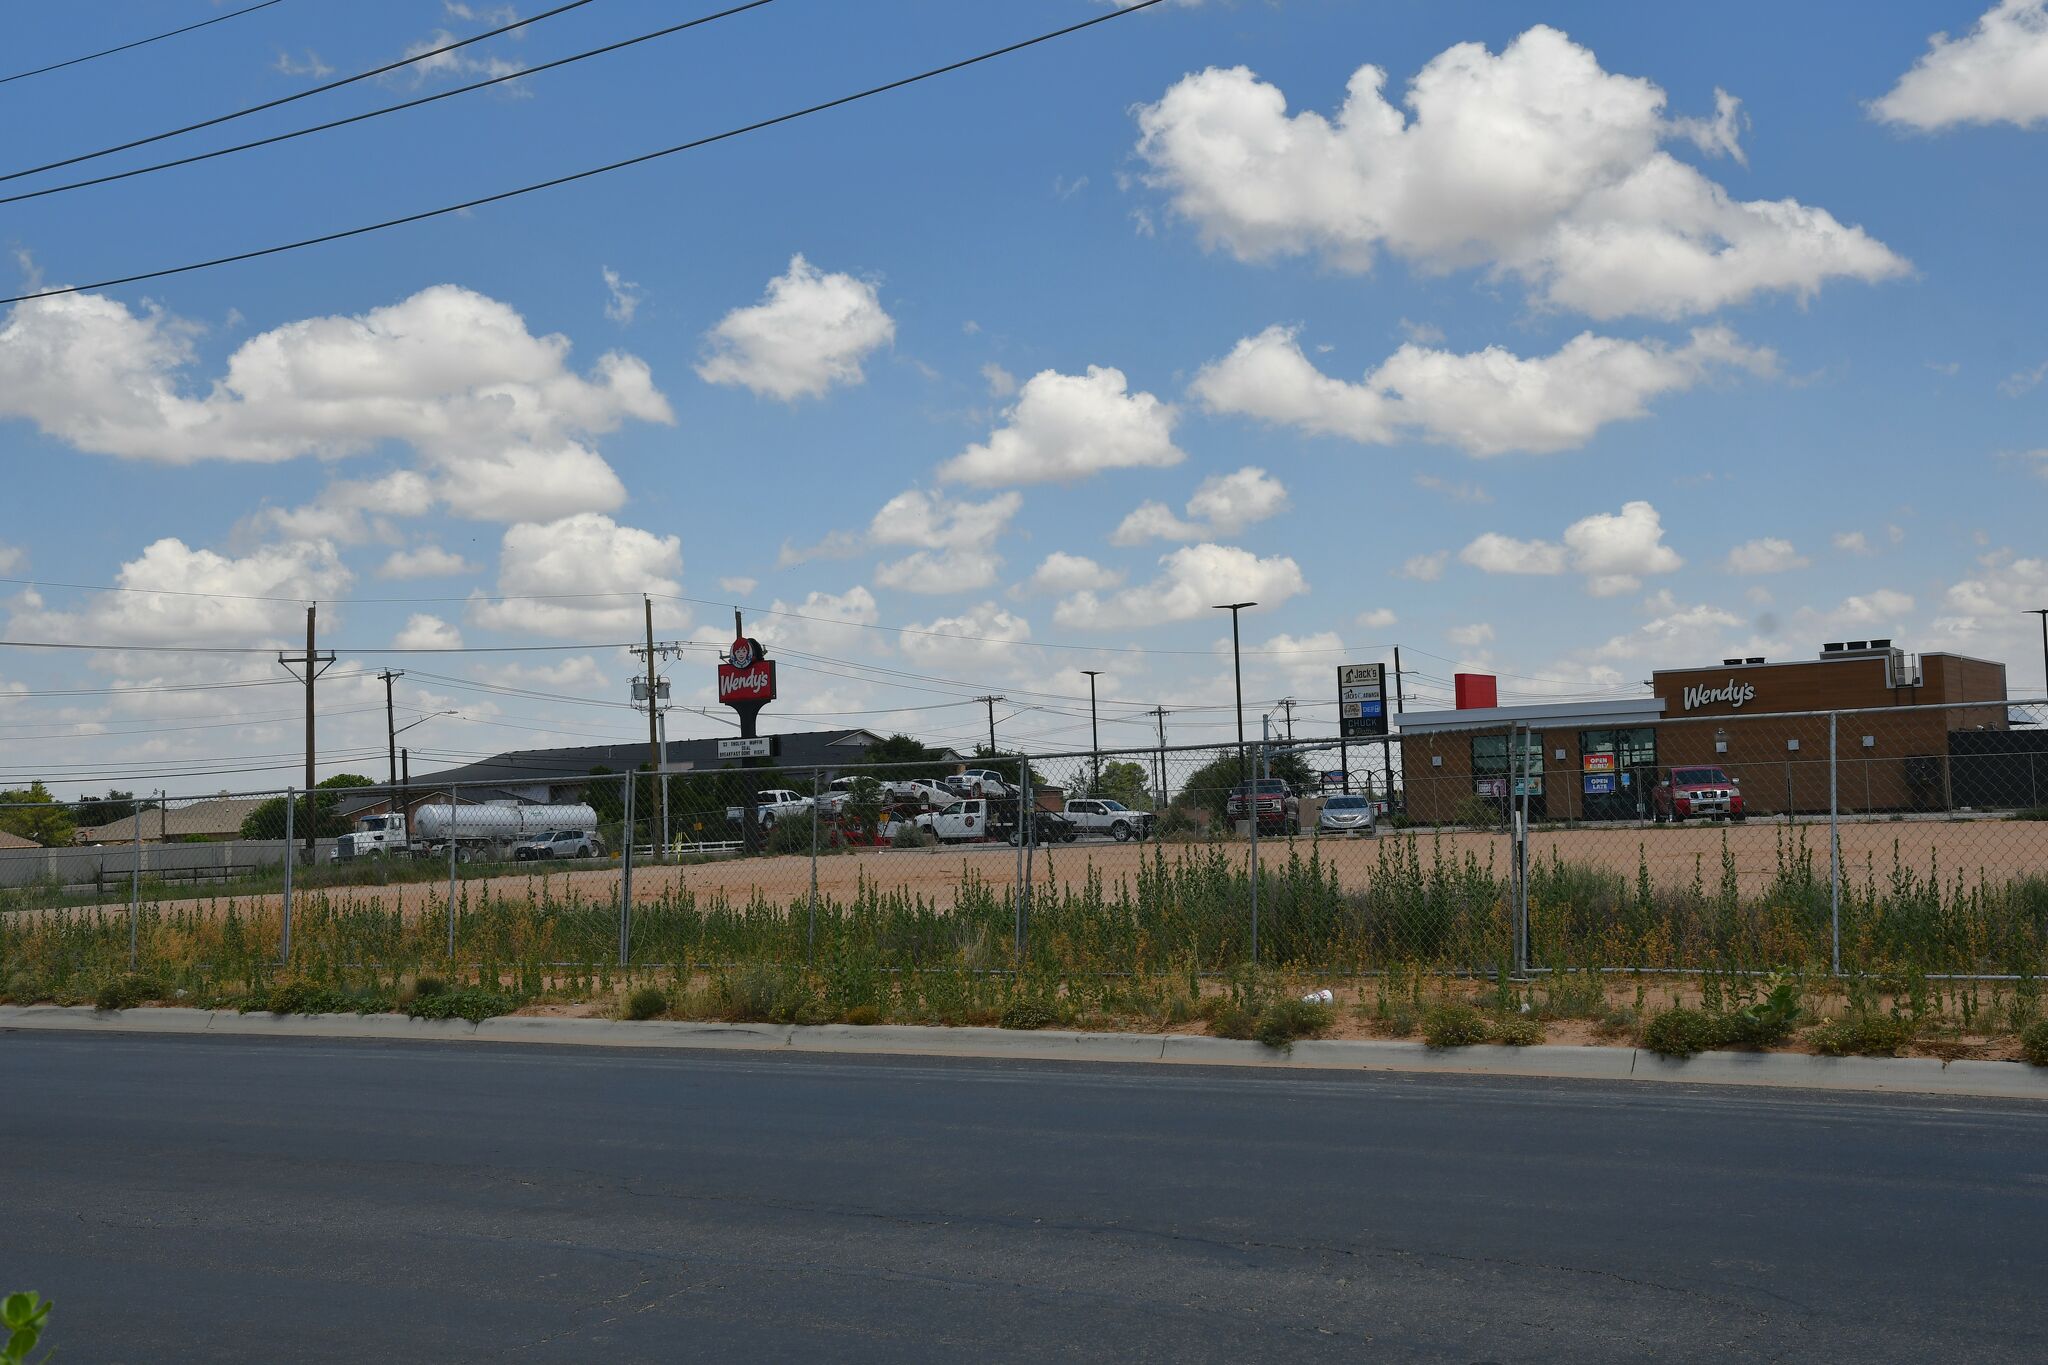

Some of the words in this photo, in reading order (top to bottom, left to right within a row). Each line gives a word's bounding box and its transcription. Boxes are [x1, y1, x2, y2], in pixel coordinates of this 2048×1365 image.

[720, 667, 768, 696] Wendy's
[1354, 668, 1377, 679] Jack's
[1683, 679, 1755, 710] Wendy's
